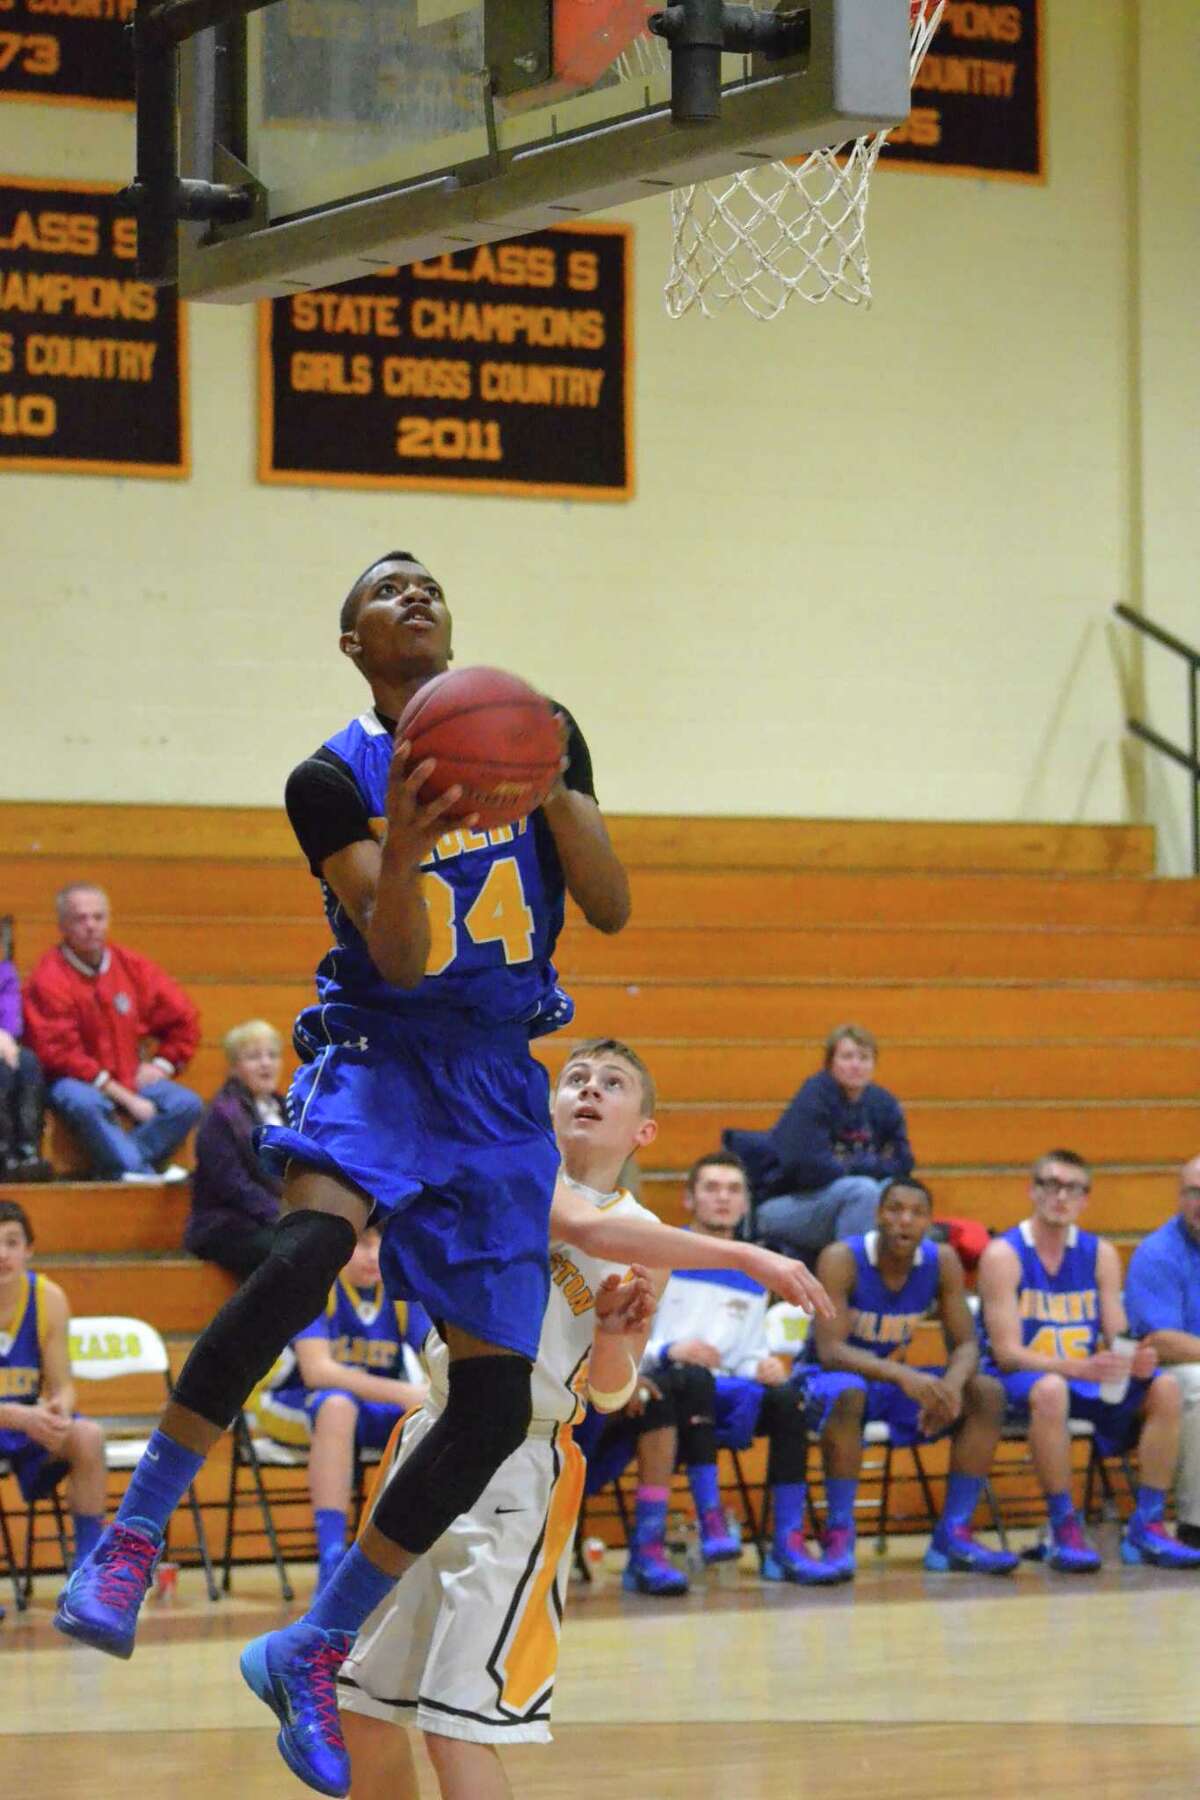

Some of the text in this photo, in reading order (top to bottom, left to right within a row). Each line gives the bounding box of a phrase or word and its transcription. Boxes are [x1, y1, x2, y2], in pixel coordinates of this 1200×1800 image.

[112, 216, 138, 260] S
[568, 251, 598, 291] S
[0, 270, 157, 322] AMPIONS
[291, 293, 605, 350] STATE CHAMPIONS
[26, 335, 158, 383] COUNTRY
[290, 351, 605, 408] GIRLS CROSS COUNTRY
[0, 392, 56, 437] 10
[397, 416, 502, 461] 2011
